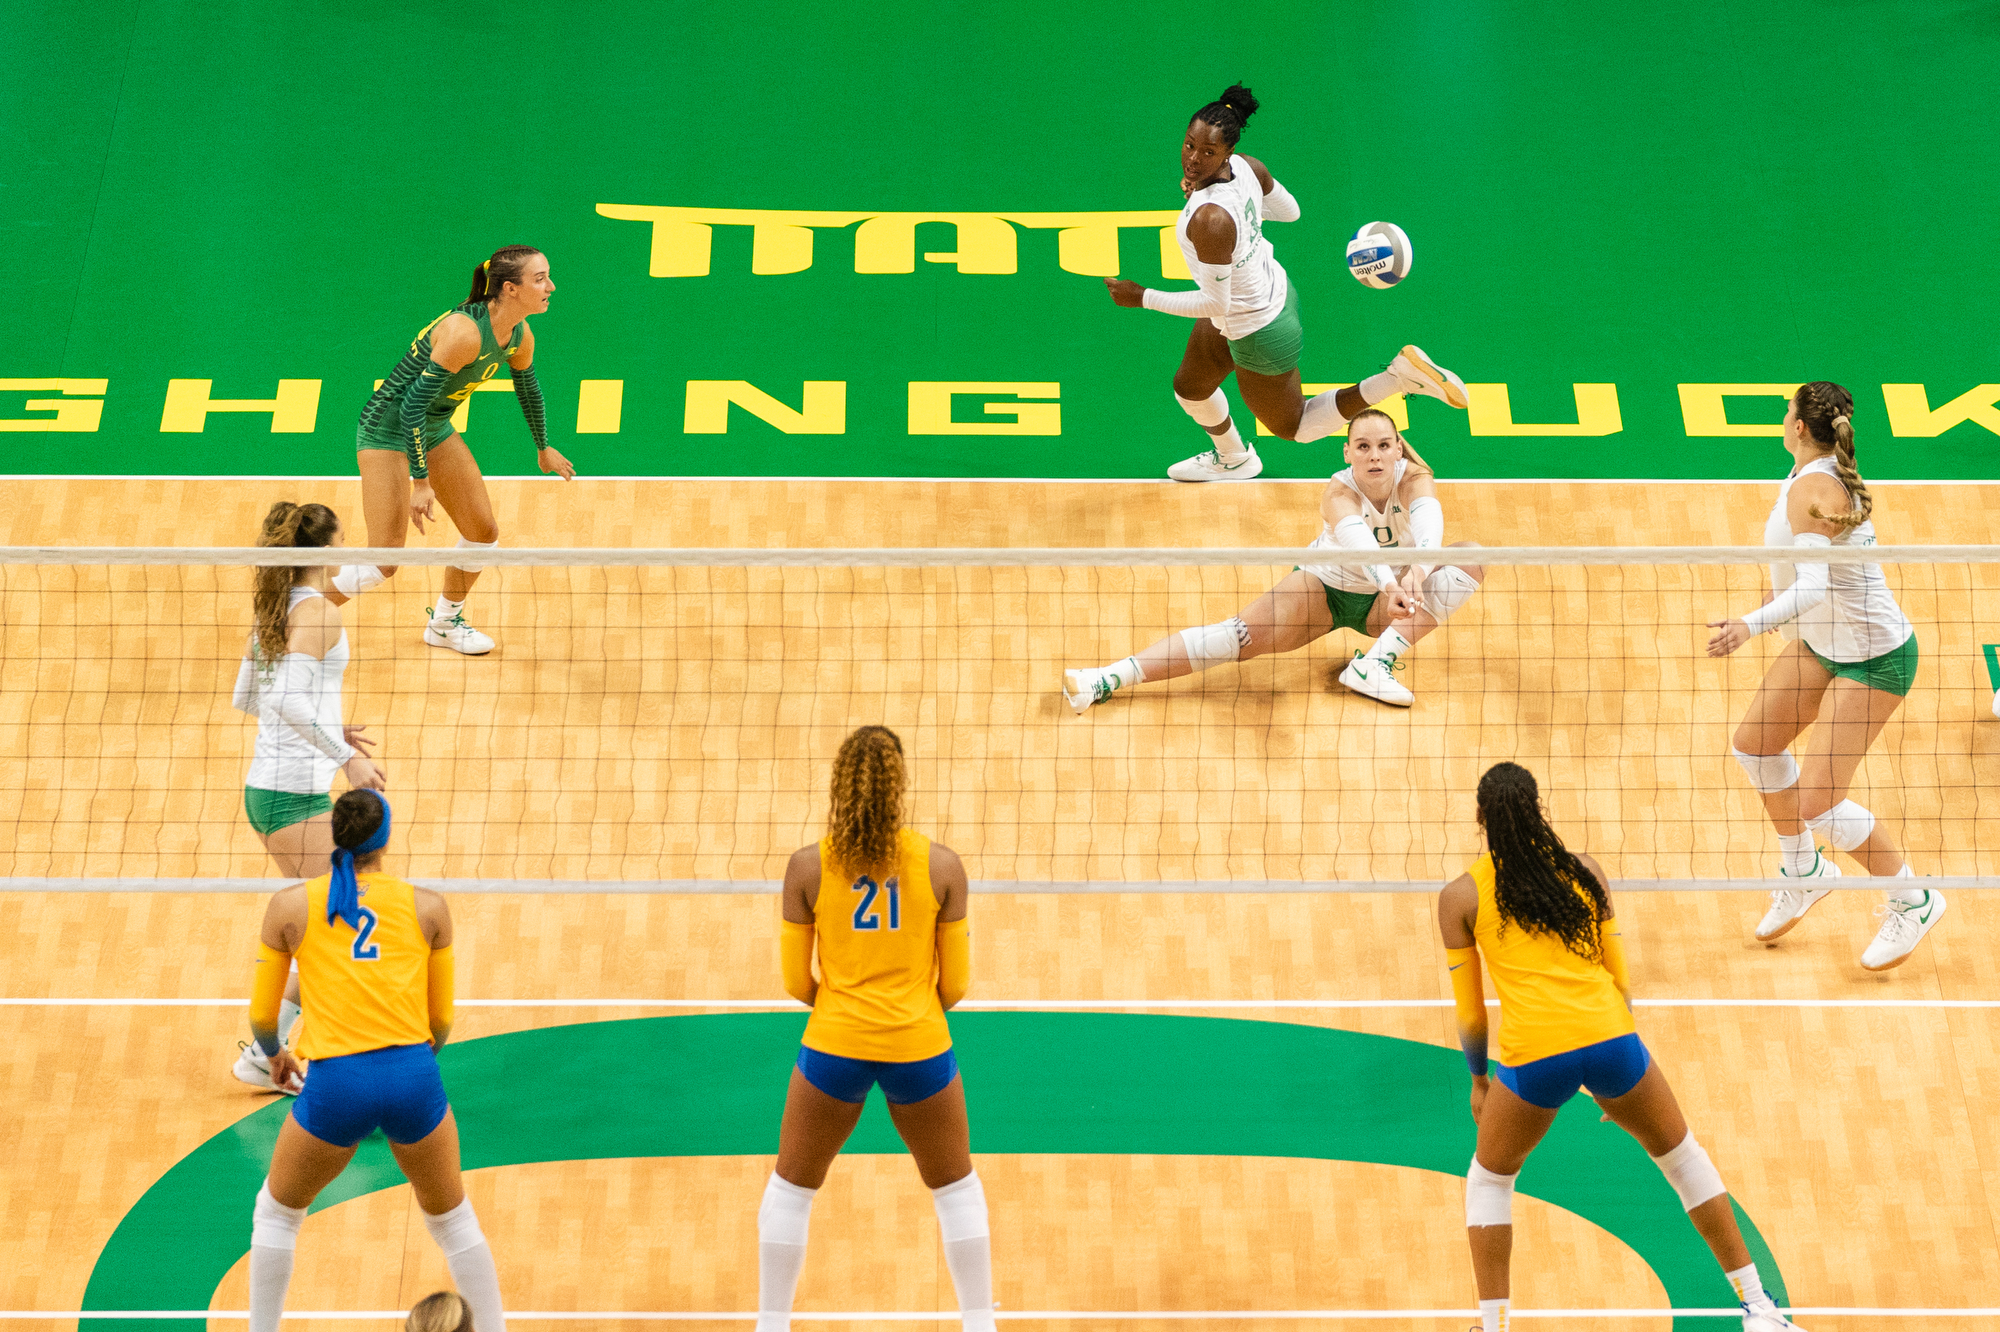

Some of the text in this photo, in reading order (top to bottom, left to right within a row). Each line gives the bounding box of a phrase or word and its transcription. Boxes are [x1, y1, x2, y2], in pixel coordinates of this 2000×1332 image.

[1354, 261, 1386, 275] molten
[413, 427, 425, 468] DUCKS
[851, 874, 900, 932] 21
[351, 906, 380, 960] 2
